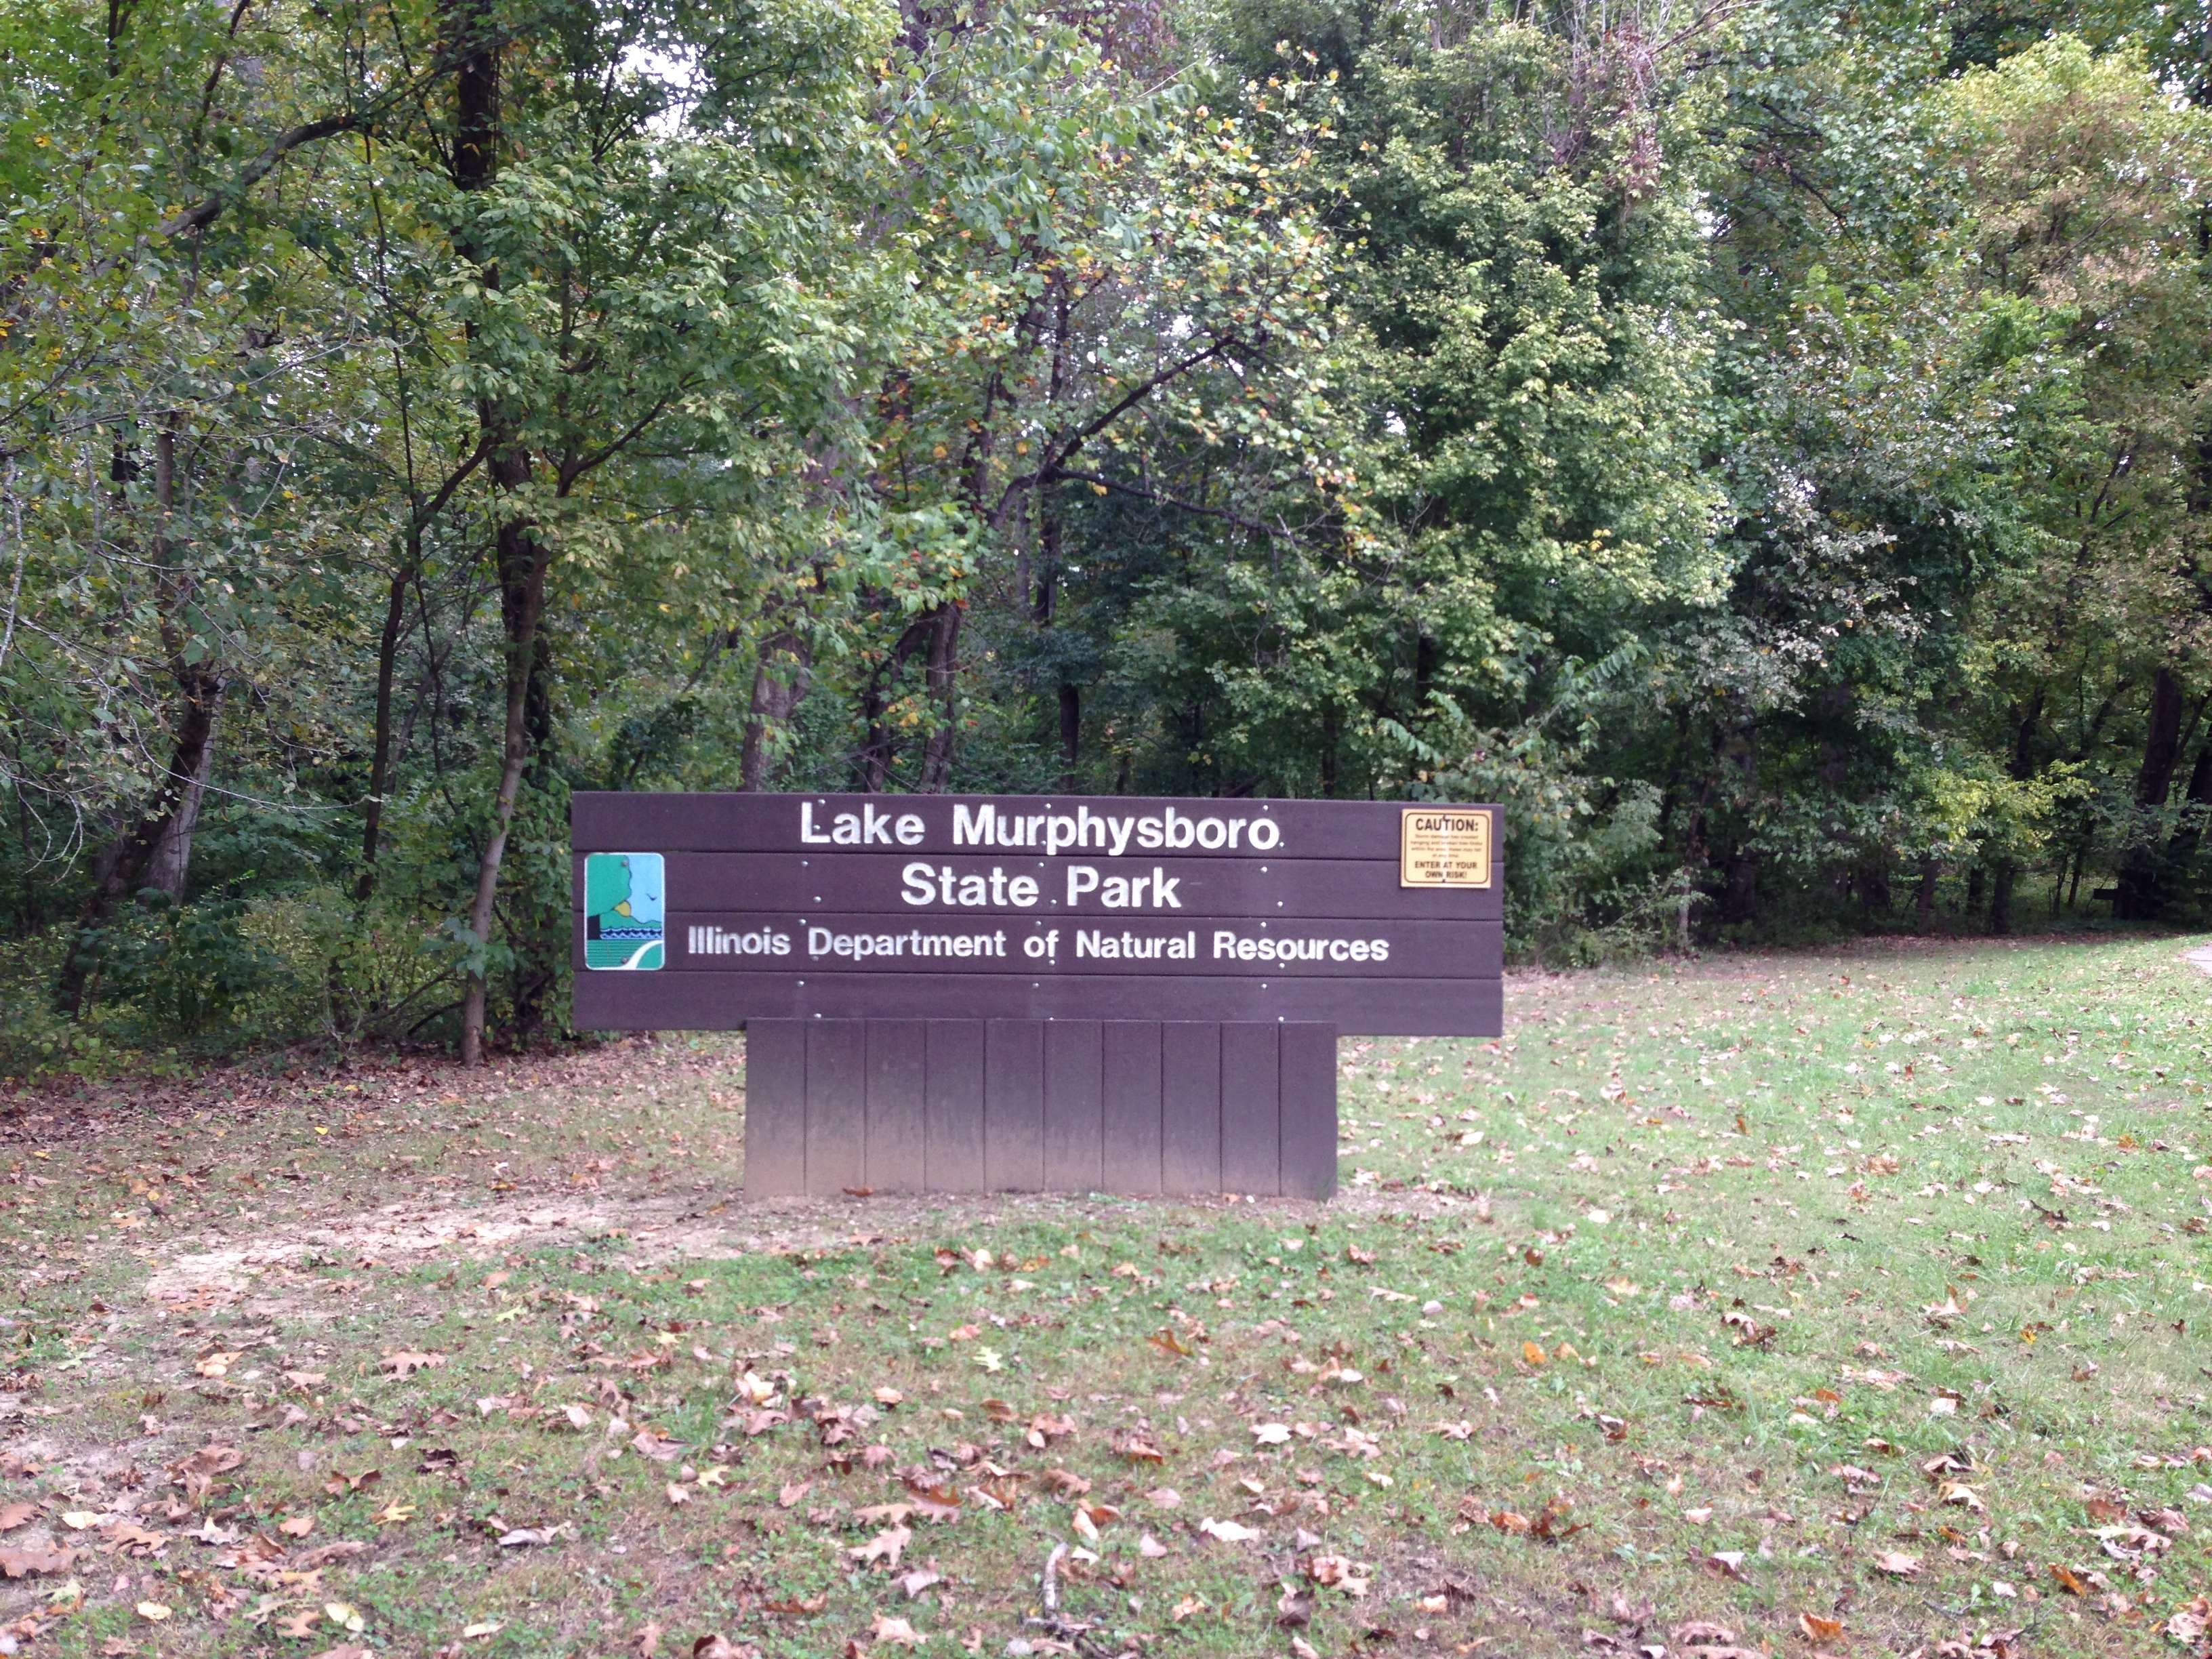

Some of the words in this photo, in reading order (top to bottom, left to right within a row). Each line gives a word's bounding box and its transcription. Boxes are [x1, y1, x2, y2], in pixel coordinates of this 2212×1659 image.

[800, 802, 925, 846] Lake
[953, 804, 1281, 857] Murphysboro
[1415, 818, 1479, 832] CAUTION:
[1414, 861, 1440, 869] ENTER
[1443, 861, 1452, 869] AT
[1456, 861, 1477, 869] YOUR
[1425, 870, 1443, 878] OWN
[1446, 871, 1467, 879] RISK!
[901, 862, 1040, 907] State
[1067, 865, 1182, 908] Park
[688, 926, 791, 956] Illinois
[808, 927, 1006, 961] Department
[1023, 929, 1059, 958] of
[1076, 930, 1195, 959] Natural
[1213, 930, 1390, 962] Resources
